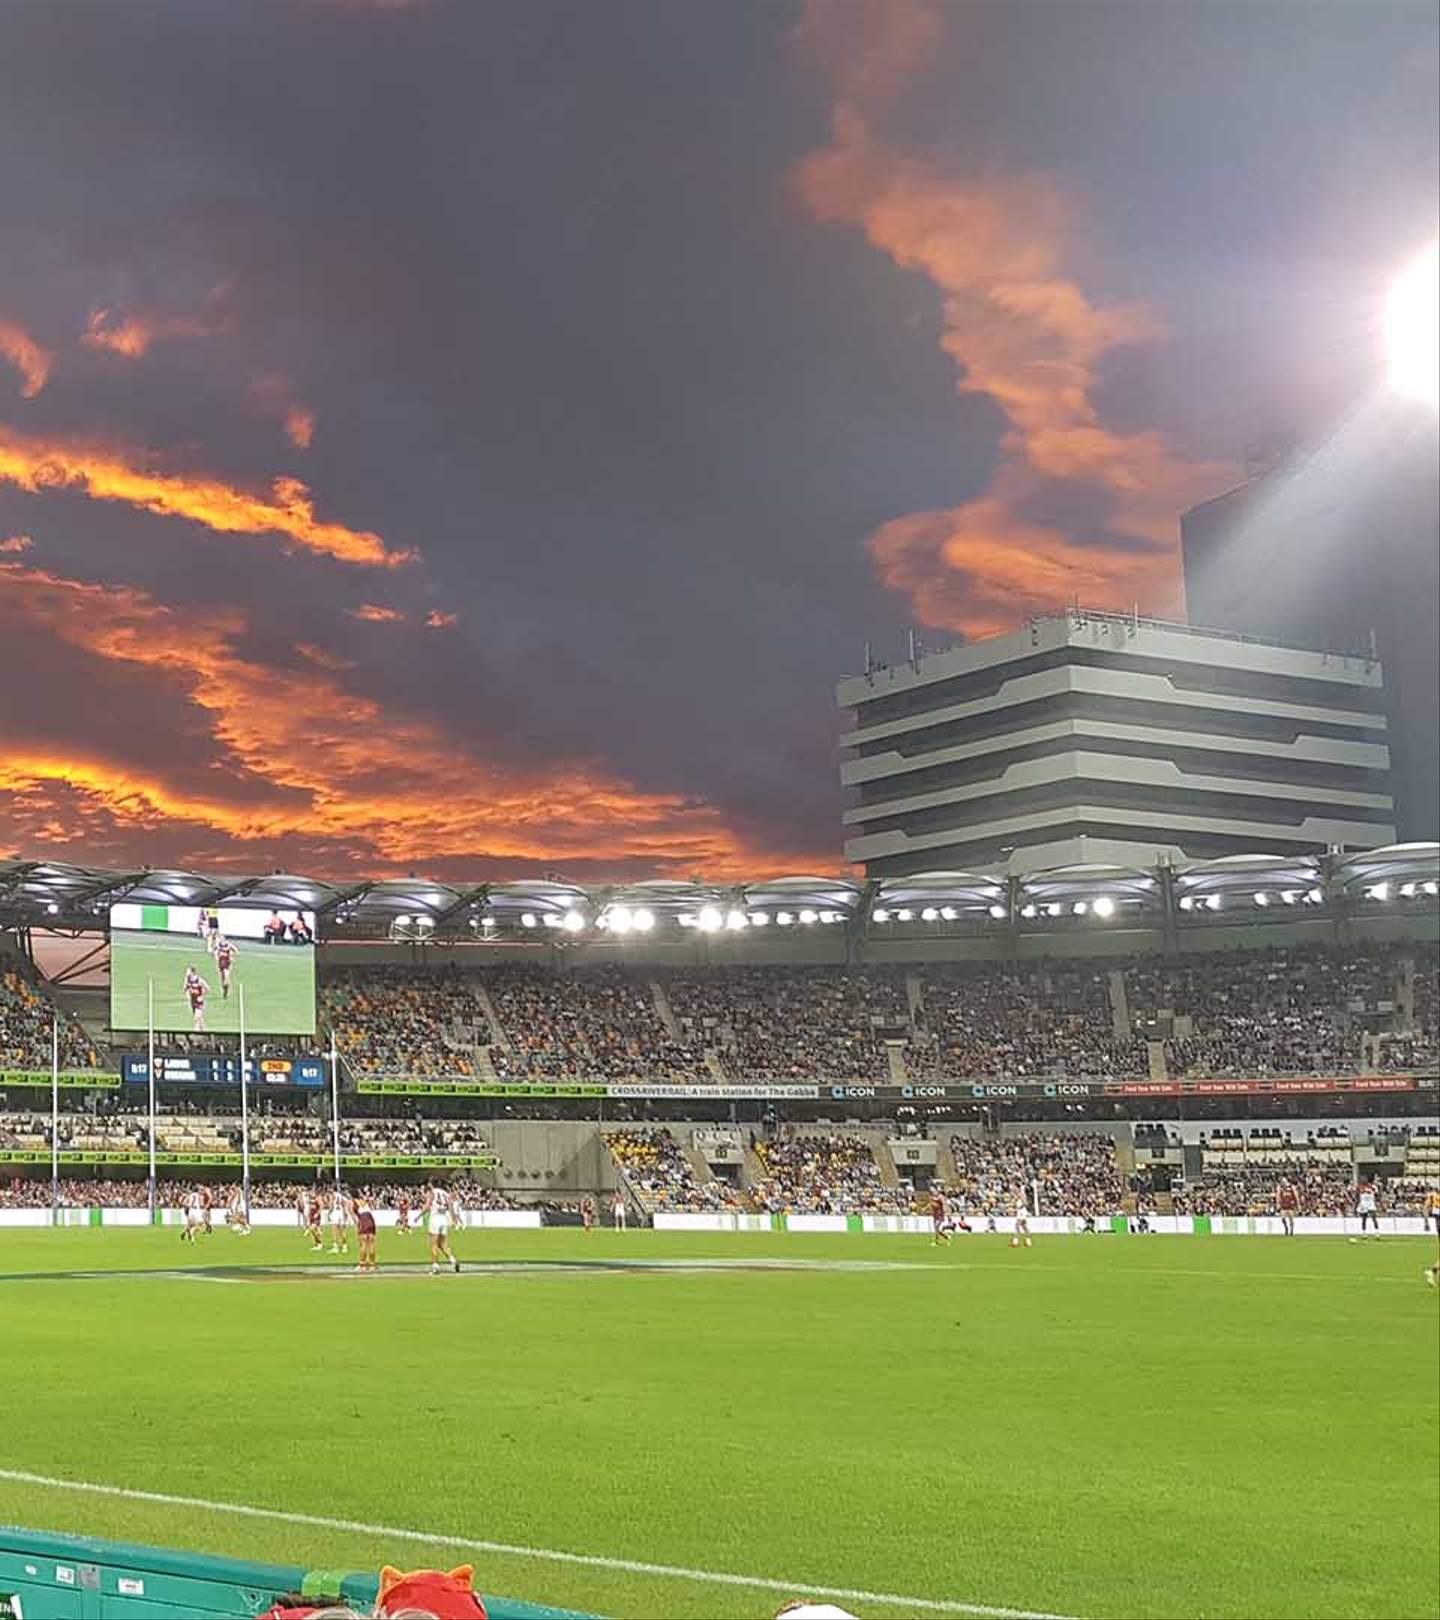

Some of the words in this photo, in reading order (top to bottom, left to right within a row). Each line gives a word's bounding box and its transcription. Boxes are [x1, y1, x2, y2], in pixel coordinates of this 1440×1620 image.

[845, 1087, 875, 1097] ICON
[915, 1086, 946, 1097] ICON
[986, 1086, 1017, 1096] ICON
[1058, 1085, 1089, 1095] ICON
